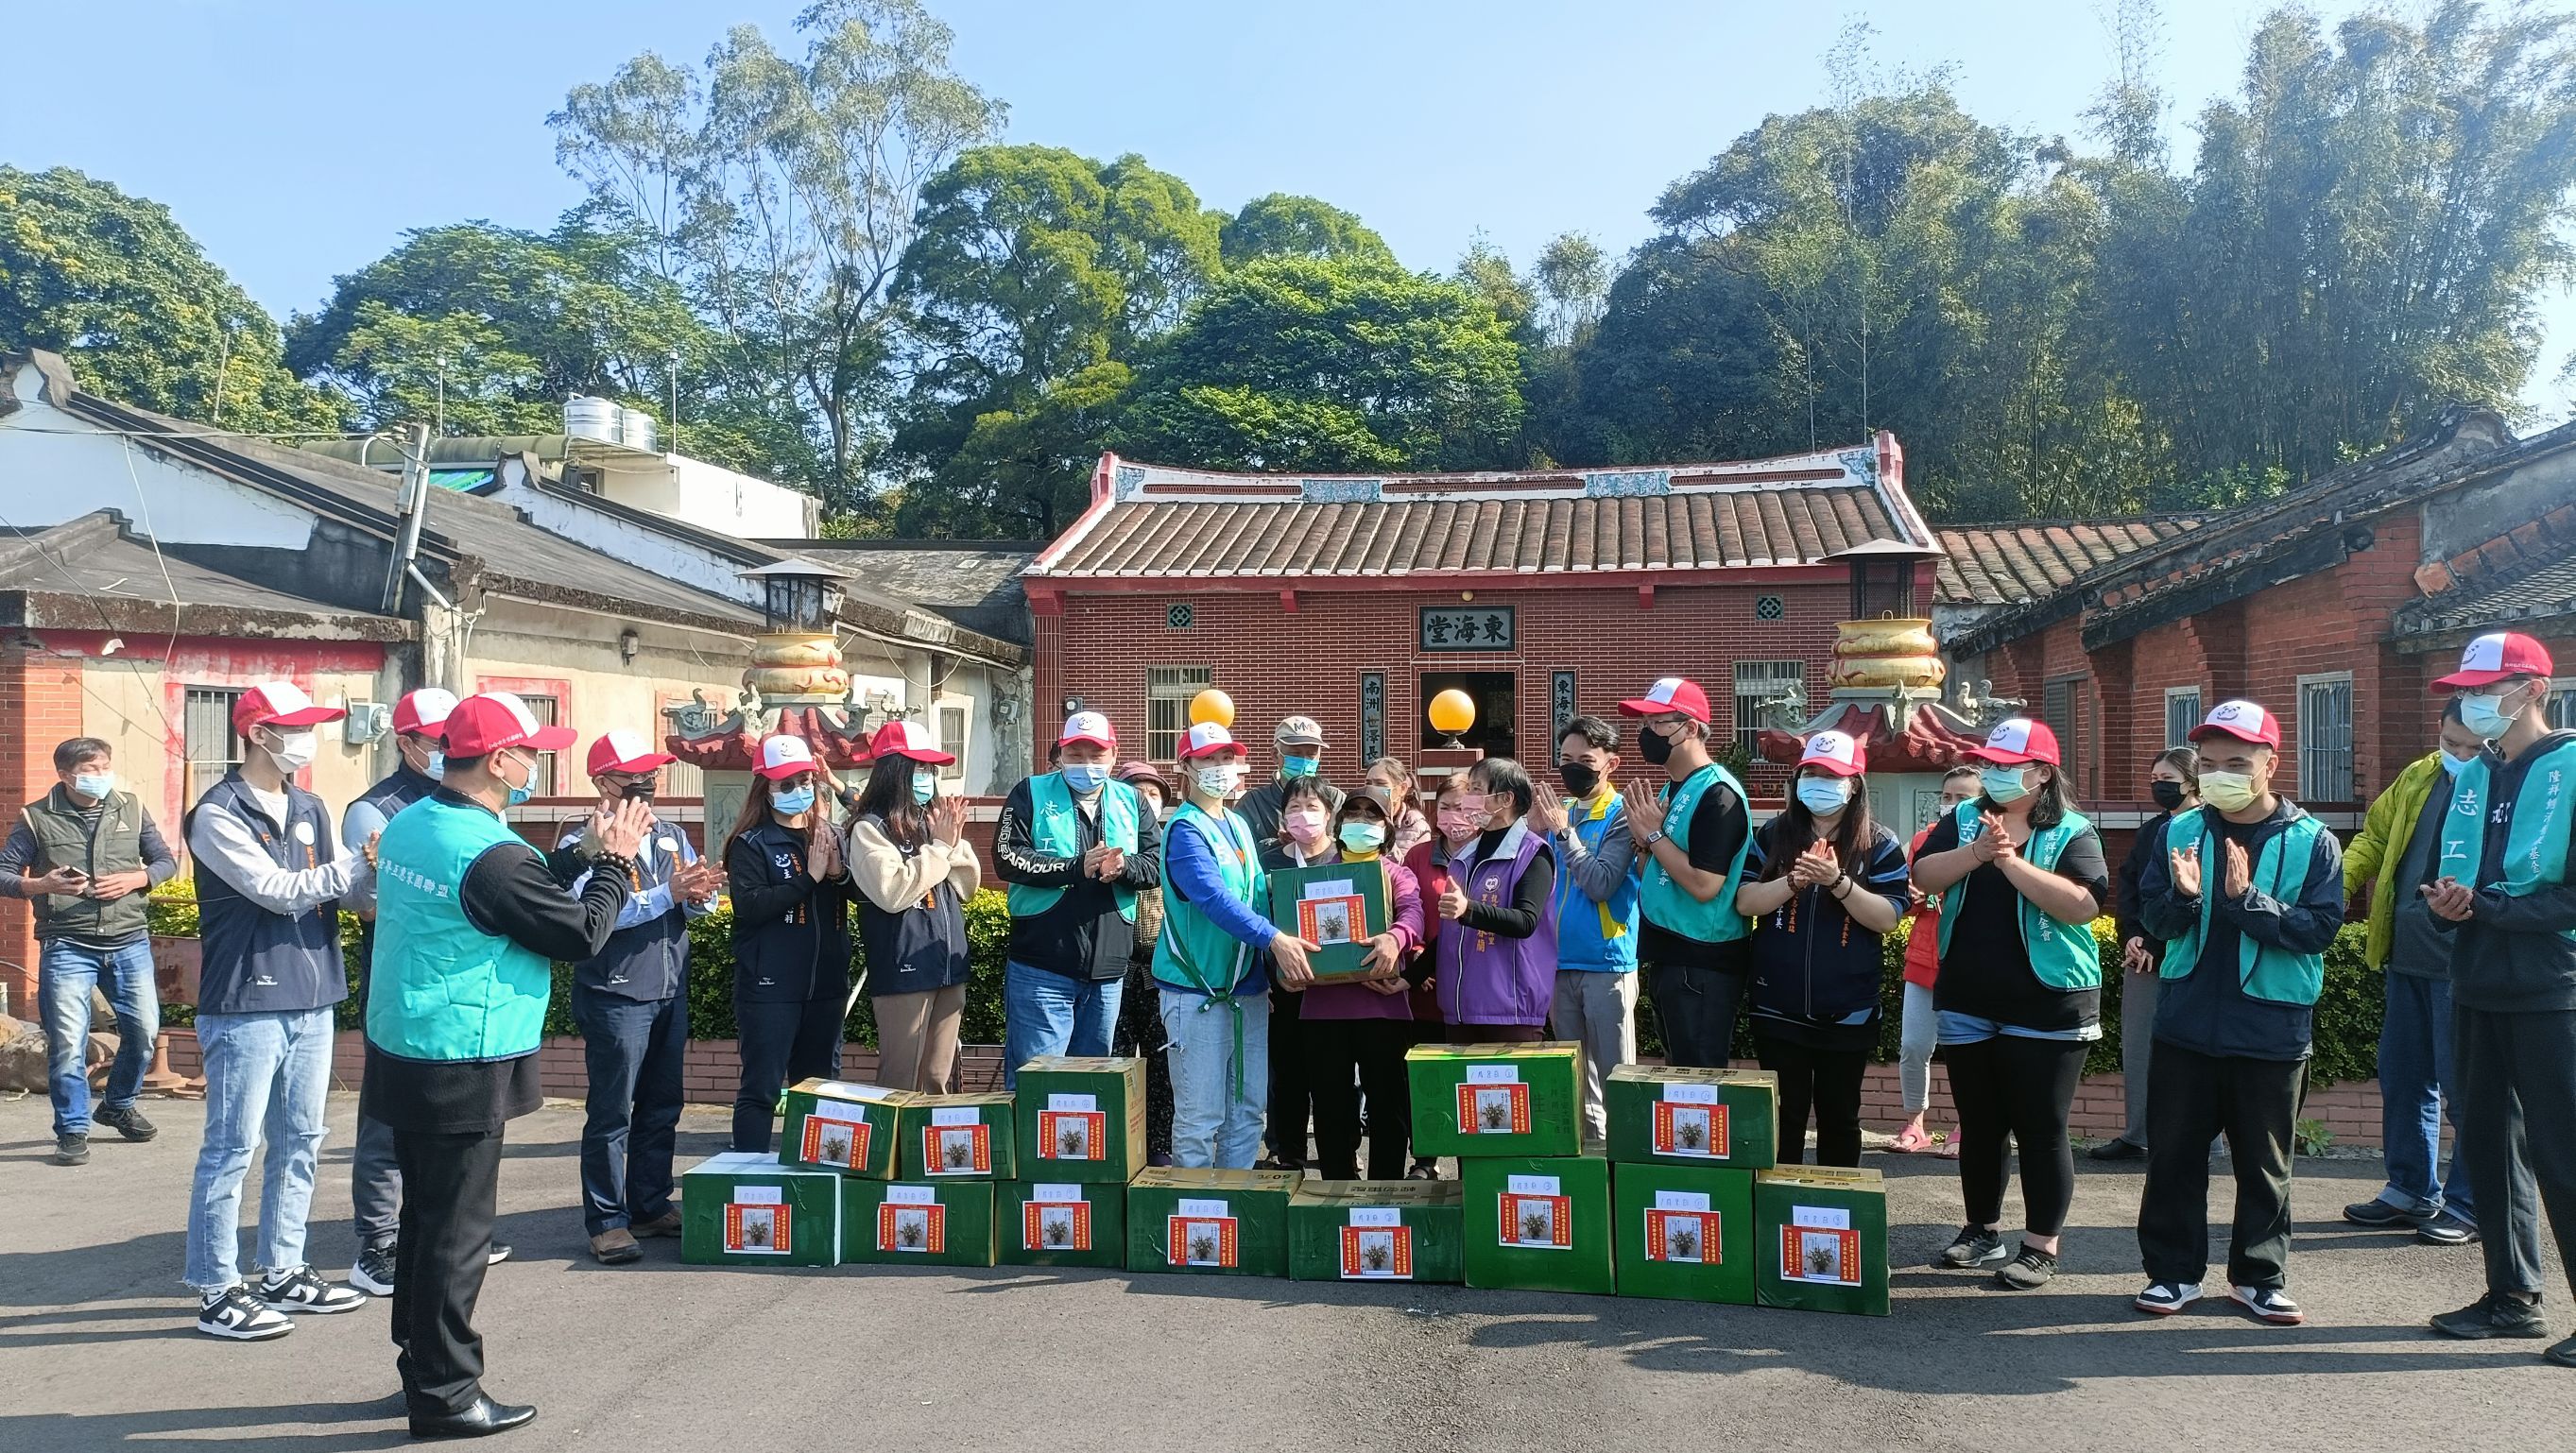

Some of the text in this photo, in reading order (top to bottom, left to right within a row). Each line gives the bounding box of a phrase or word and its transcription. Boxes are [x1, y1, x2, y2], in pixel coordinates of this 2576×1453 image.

[1426, 614, 1507, 643] 東海堂
[1036, 800, 1062, 852] 志工
[2442, 789, 2479, 859] 志工
